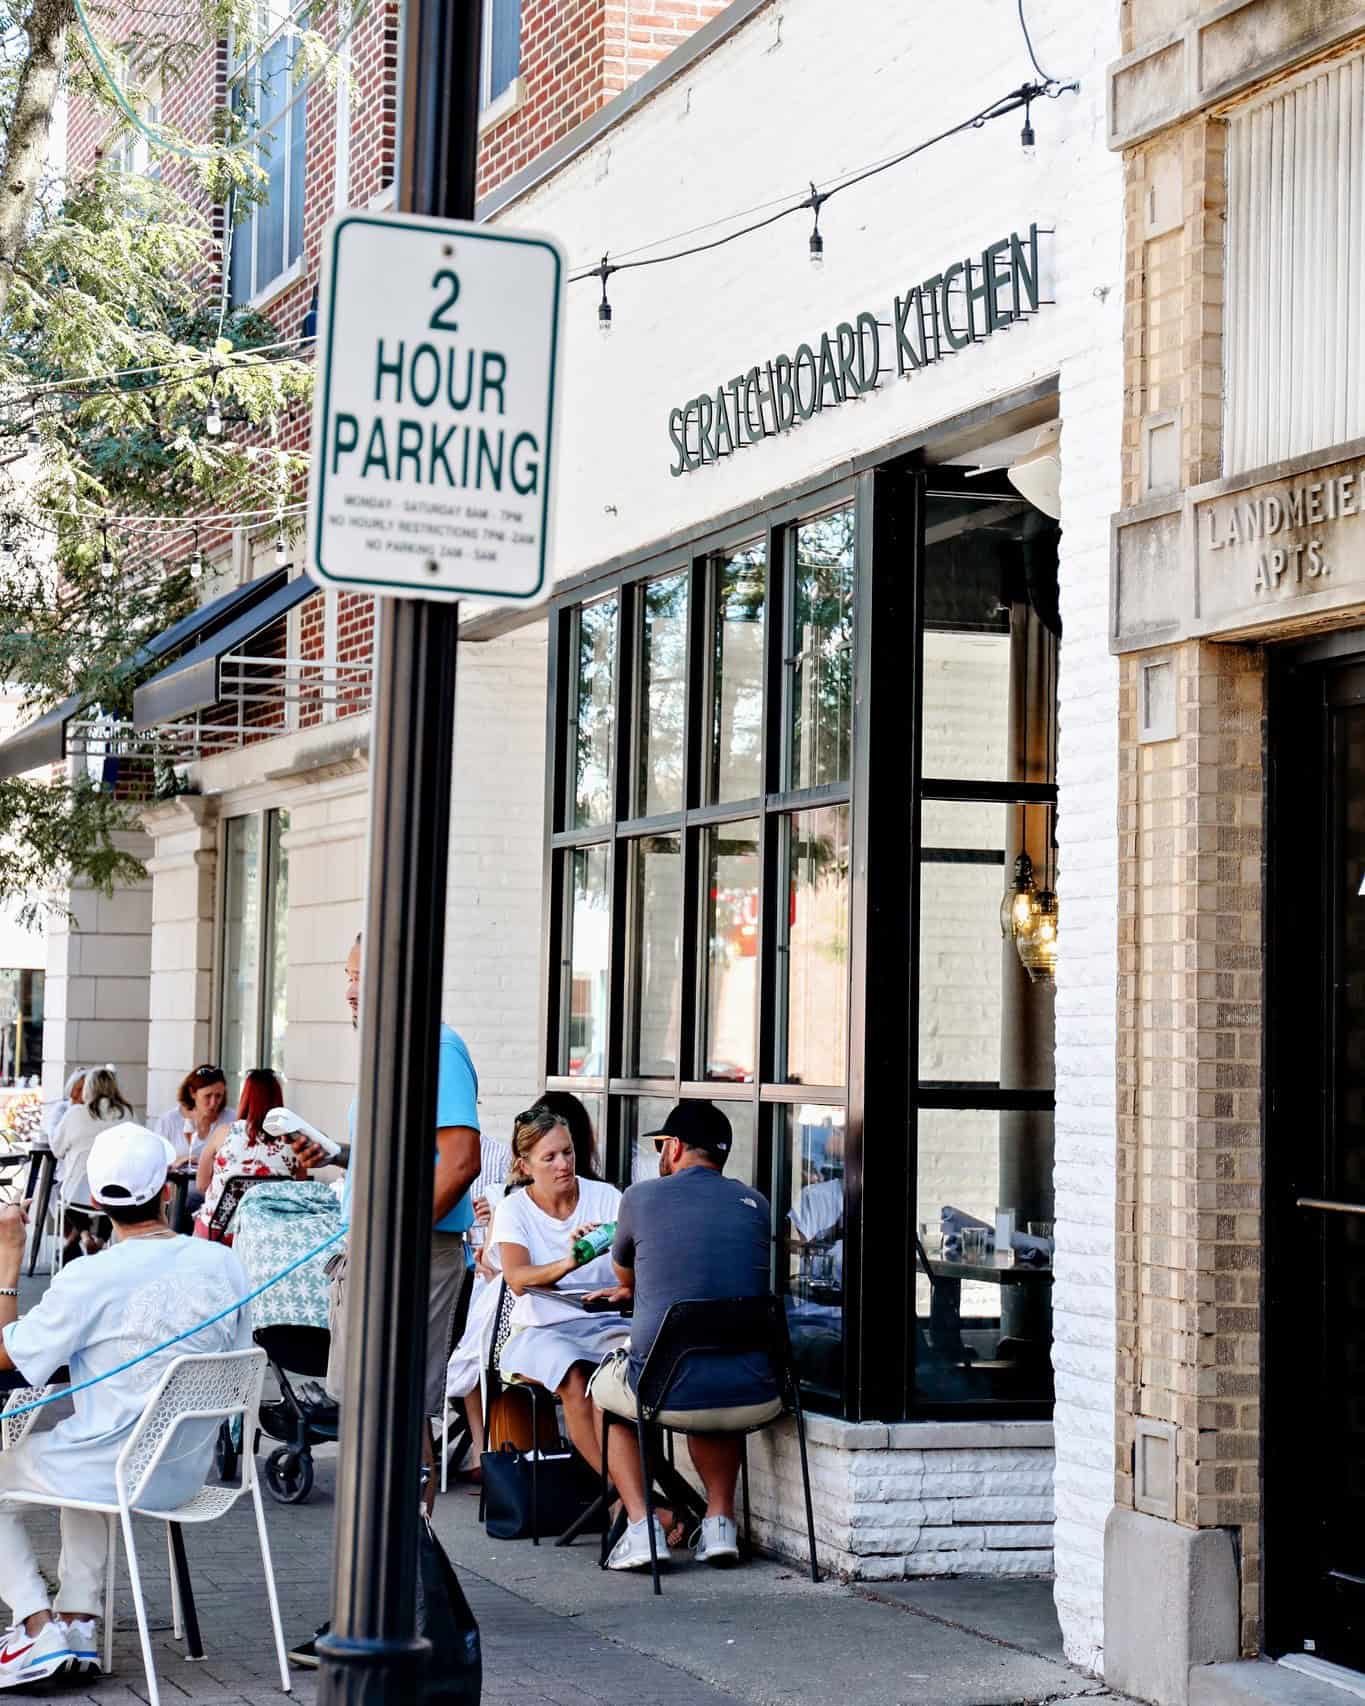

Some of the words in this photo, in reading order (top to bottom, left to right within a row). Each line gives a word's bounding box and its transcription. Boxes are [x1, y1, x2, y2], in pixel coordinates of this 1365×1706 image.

[428, 268, 461, 333] 2
[374, 337, 507, 416] HOUR
[669, 311, 880, 477] SCRATCHBOARD
[893, 222, 1039, 376] KITCHEN
[332, 412, 539, 497] PARKING
[328, 514, 345, 528] NO
[348, 516, 394, 531] HOURLY
[398, 520, 479, 540] RESTRICTIONS
[343, 493, 392, 510] MONDAY
[403, 499, 462, 516] SATURDAY
[1208, 470, 1365, 551] LANDMEIE
[365, 539, 382, 551] NO
[386, 540, 435, 557] PARKING
[1254, 540, 1331, 594] APTS.
